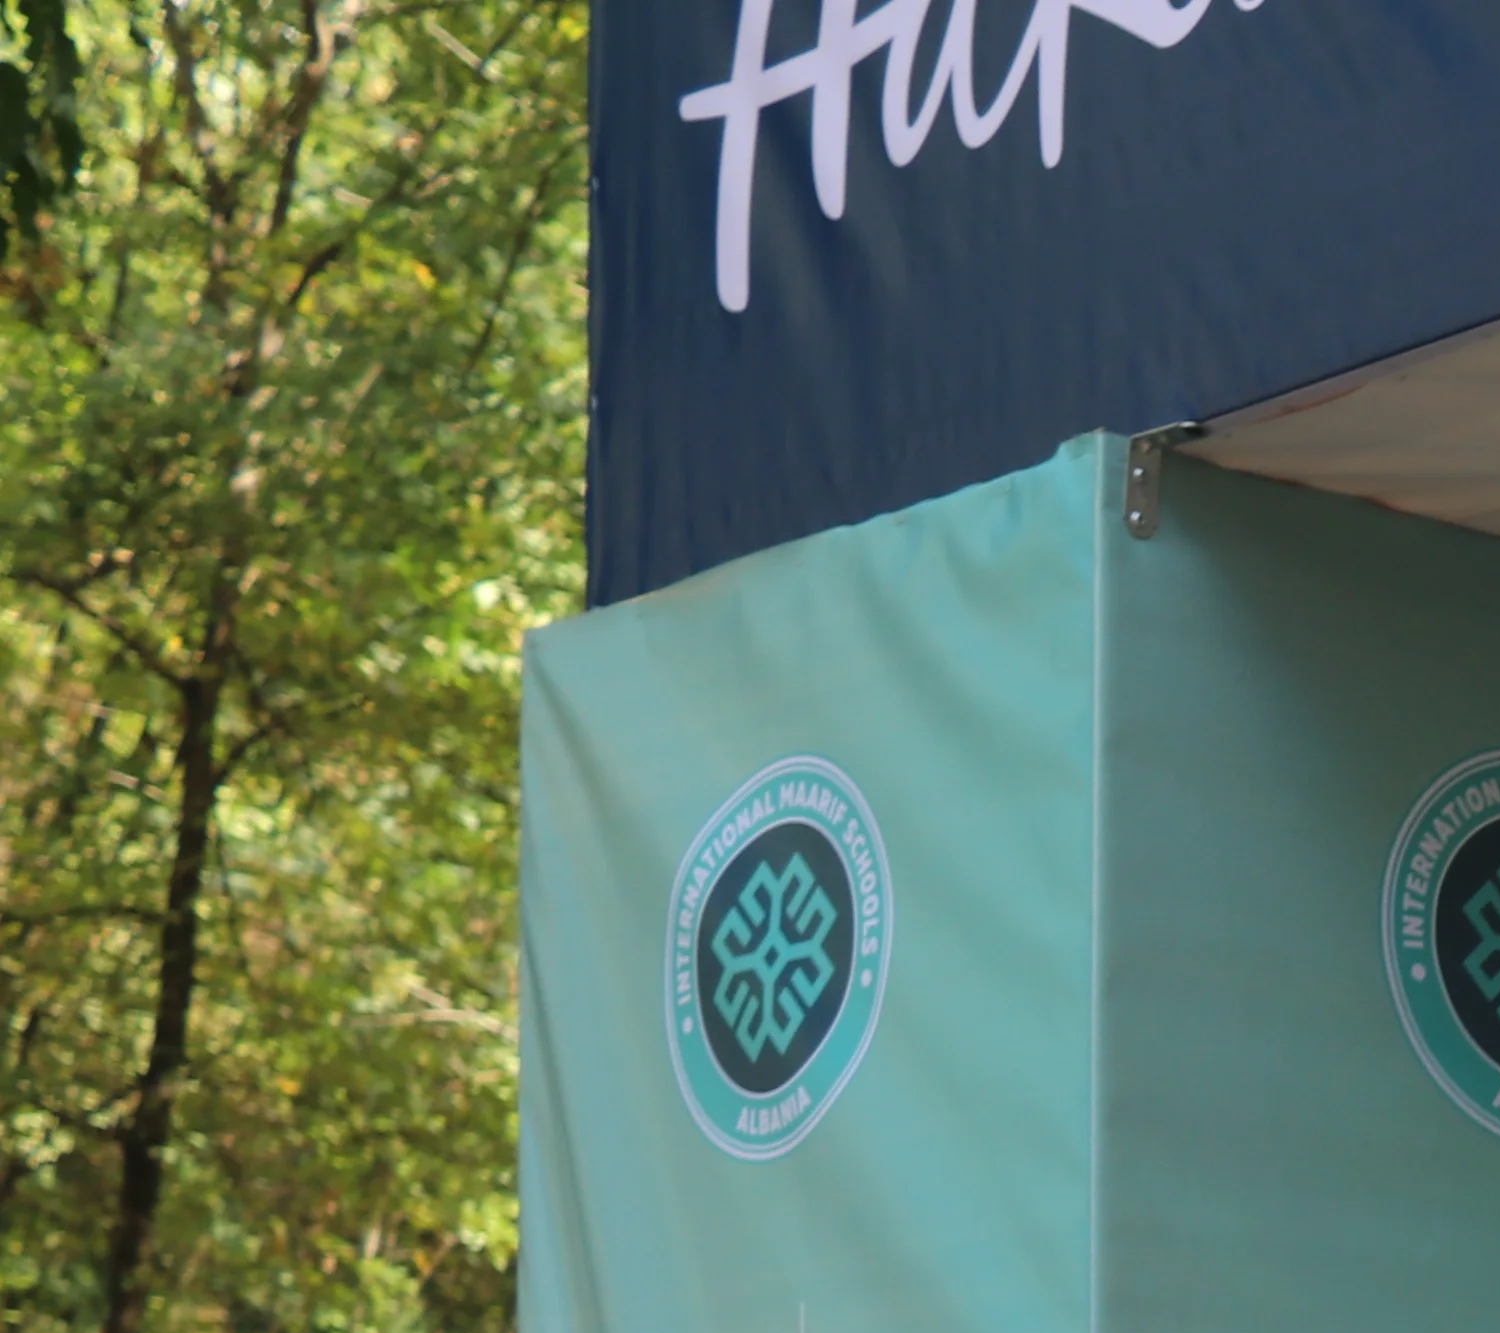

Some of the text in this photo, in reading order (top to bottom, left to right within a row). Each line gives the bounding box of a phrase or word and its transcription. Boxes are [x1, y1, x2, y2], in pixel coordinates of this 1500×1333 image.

[677, 781, 880, 1005] INTERNATIONAL MAARIF SCHOOLS
[735, 1085, 813, 1137] ALBANIA
